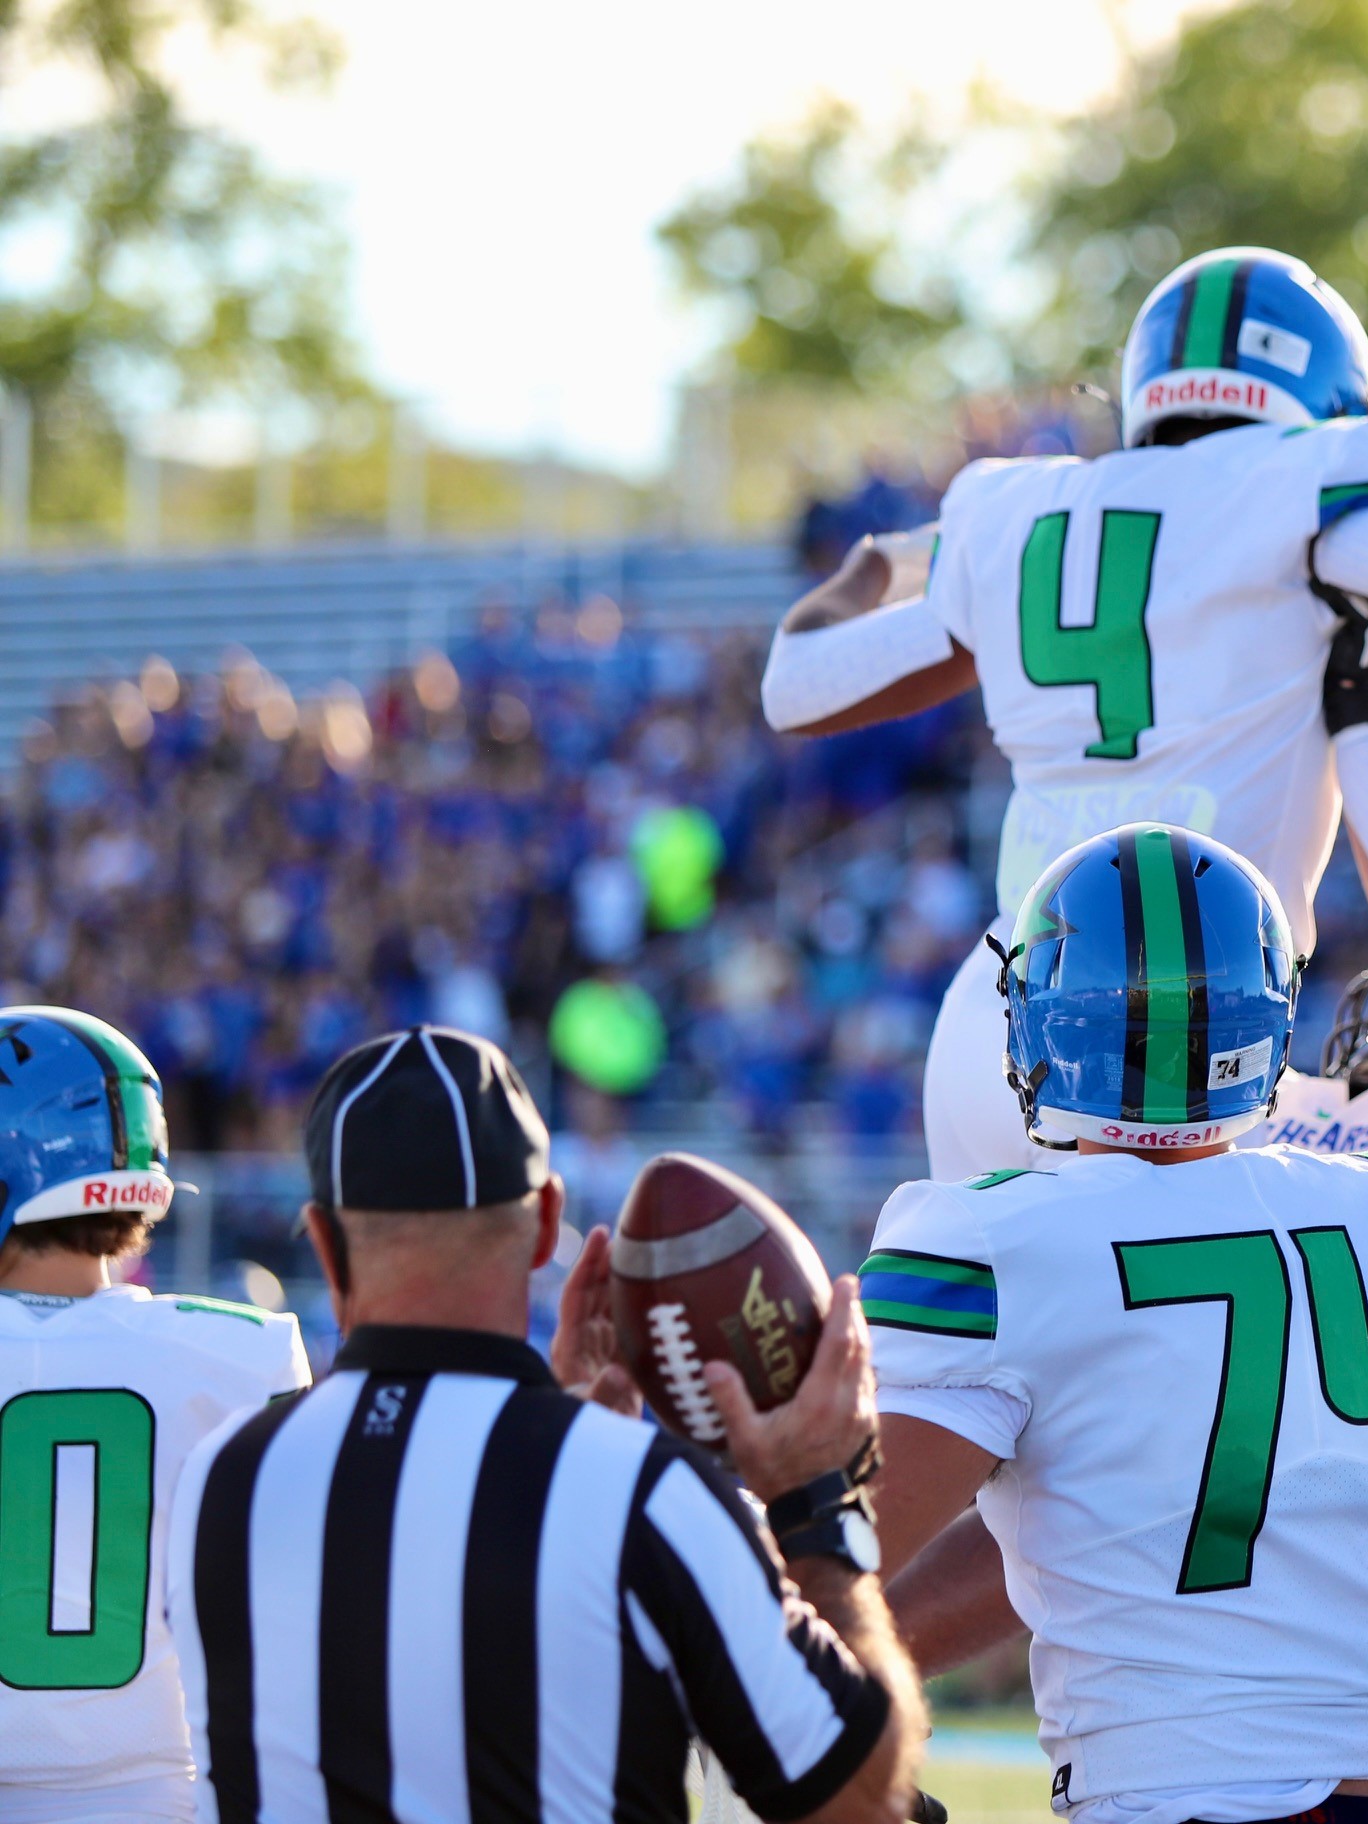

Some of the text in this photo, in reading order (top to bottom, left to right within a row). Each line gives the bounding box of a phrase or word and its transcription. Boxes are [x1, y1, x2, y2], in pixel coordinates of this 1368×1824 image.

[1145, 377, 1268, 412] Riddell
[1018, 509, 1162, 760] 4
[1217, 1057, 1240, 1080] 74
